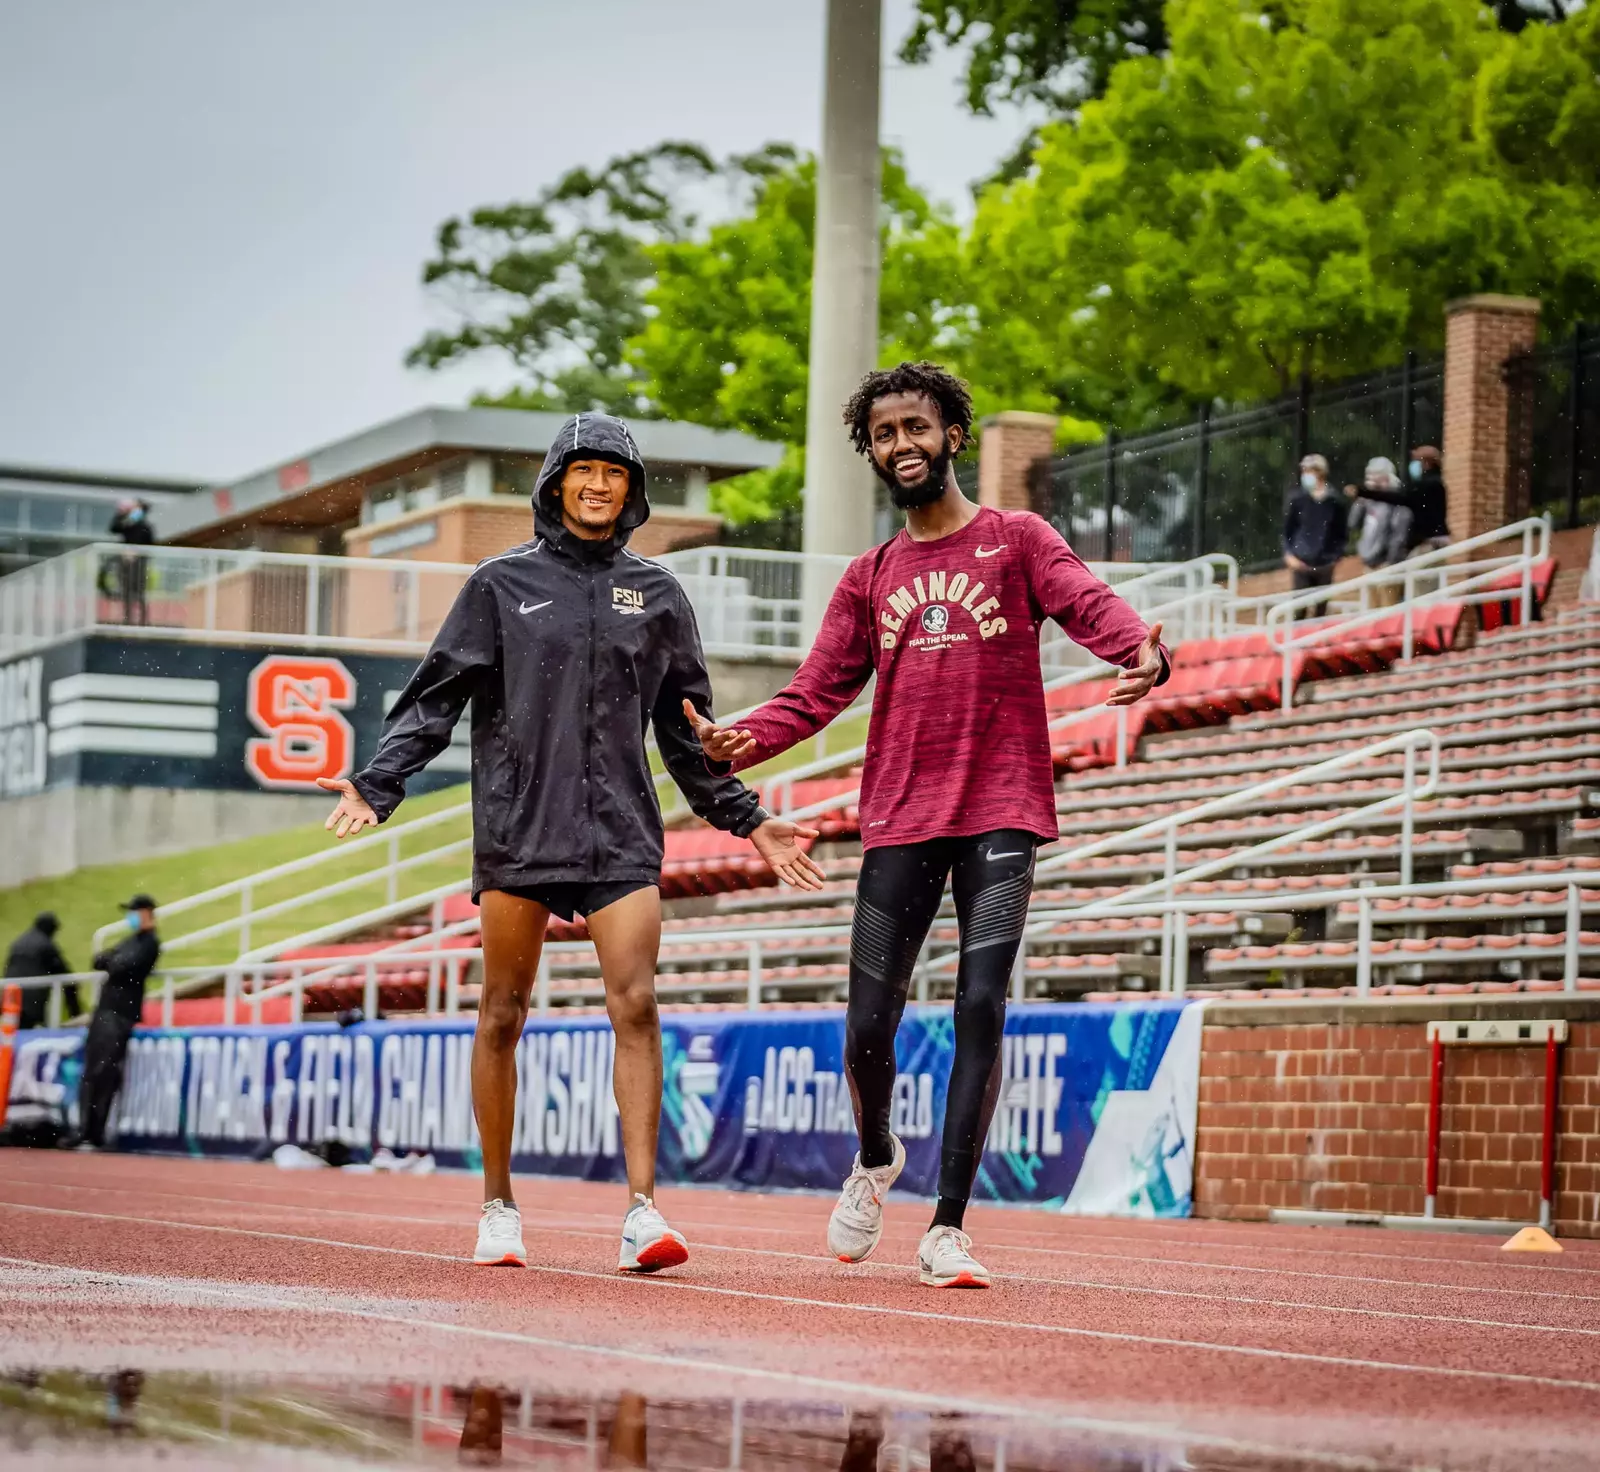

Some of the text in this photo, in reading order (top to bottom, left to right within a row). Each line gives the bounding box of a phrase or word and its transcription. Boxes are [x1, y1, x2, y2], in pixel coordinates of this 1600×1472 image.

[612, 587, 644, 607] FSU
[909, 638, 925, 648] FEAR
[927, 636, 940, 645] THE
